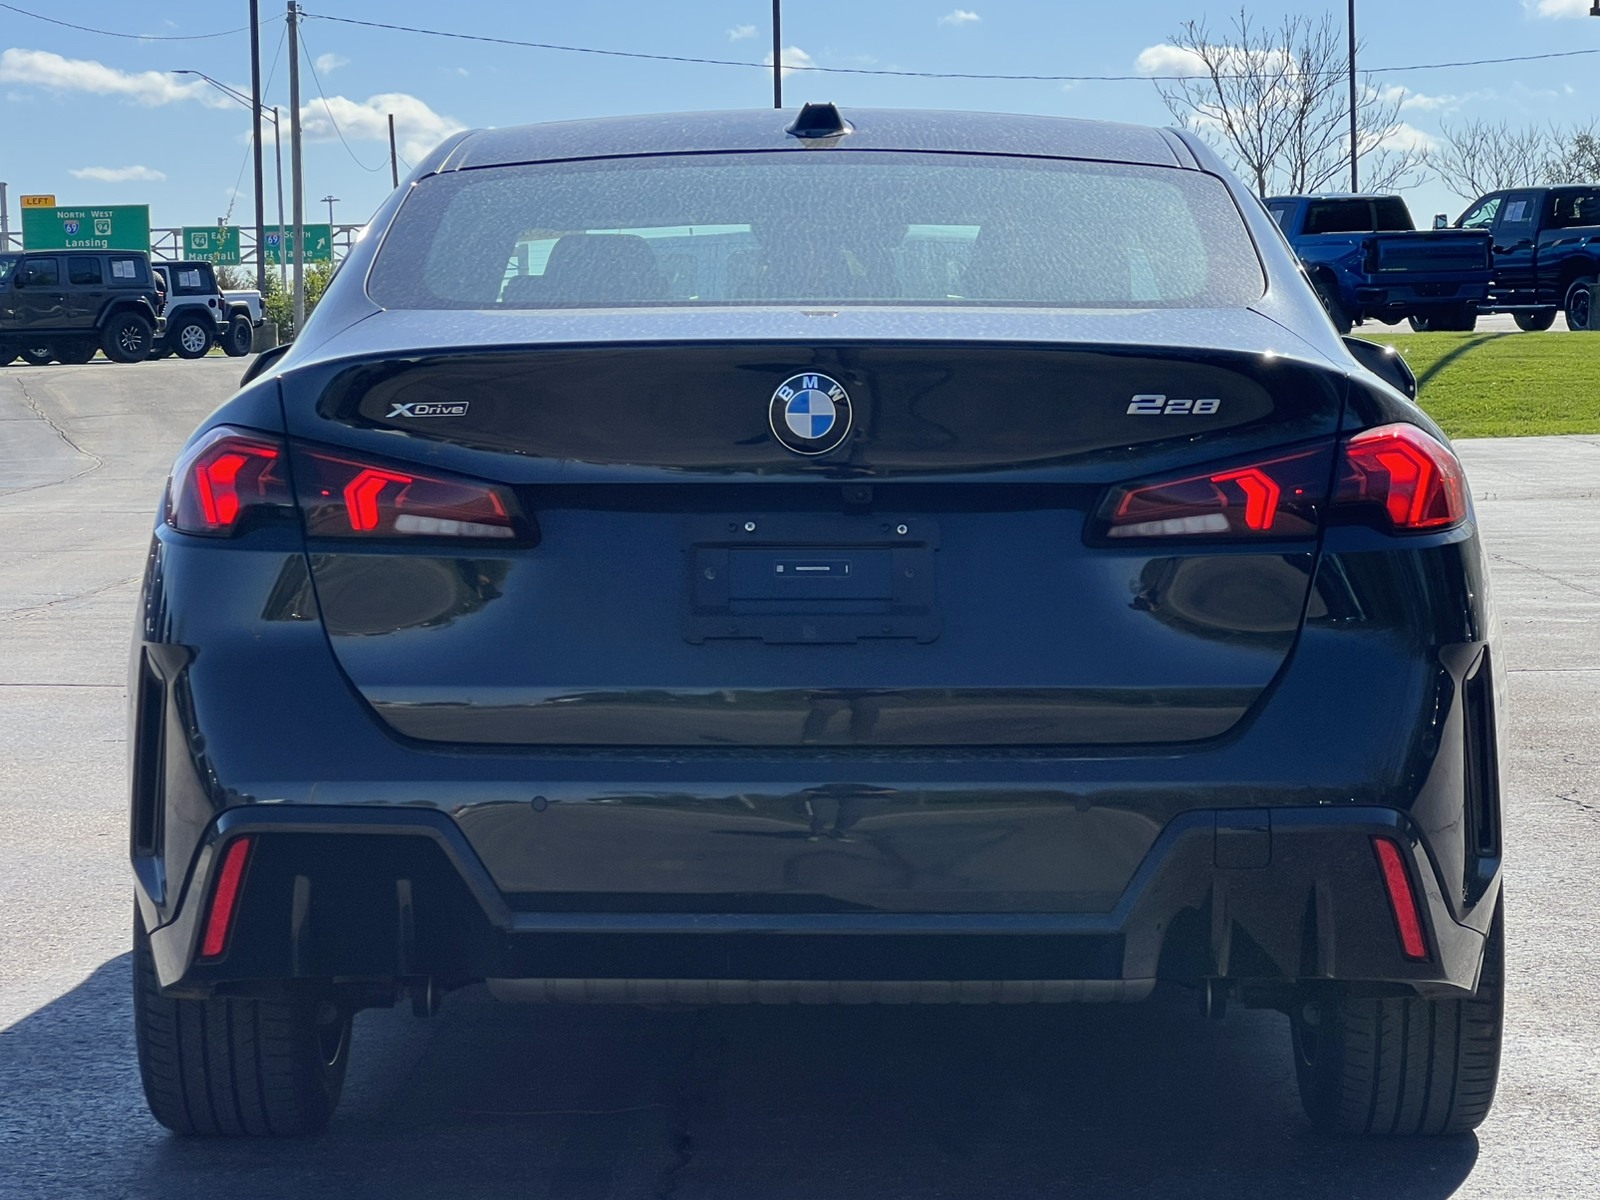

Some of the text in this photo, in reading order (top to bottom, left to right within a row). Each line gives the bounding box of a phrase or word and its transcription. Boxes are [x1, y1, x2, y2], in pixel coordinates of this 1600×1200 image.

[26, 197, 49, 205] LEFT
[57, 210, 113, 219] NORTH WEST
[66, 223, 108, 233] 69 94
[65, 238, 108, 249] Lansing
[194, 237, 205, 245] 94
[267, 235, 279, 244] 69
[264, 250, 274, 258] Ft
[778, 376, 844, 402] BMW
[1126, 394, 1220, 415] 228
